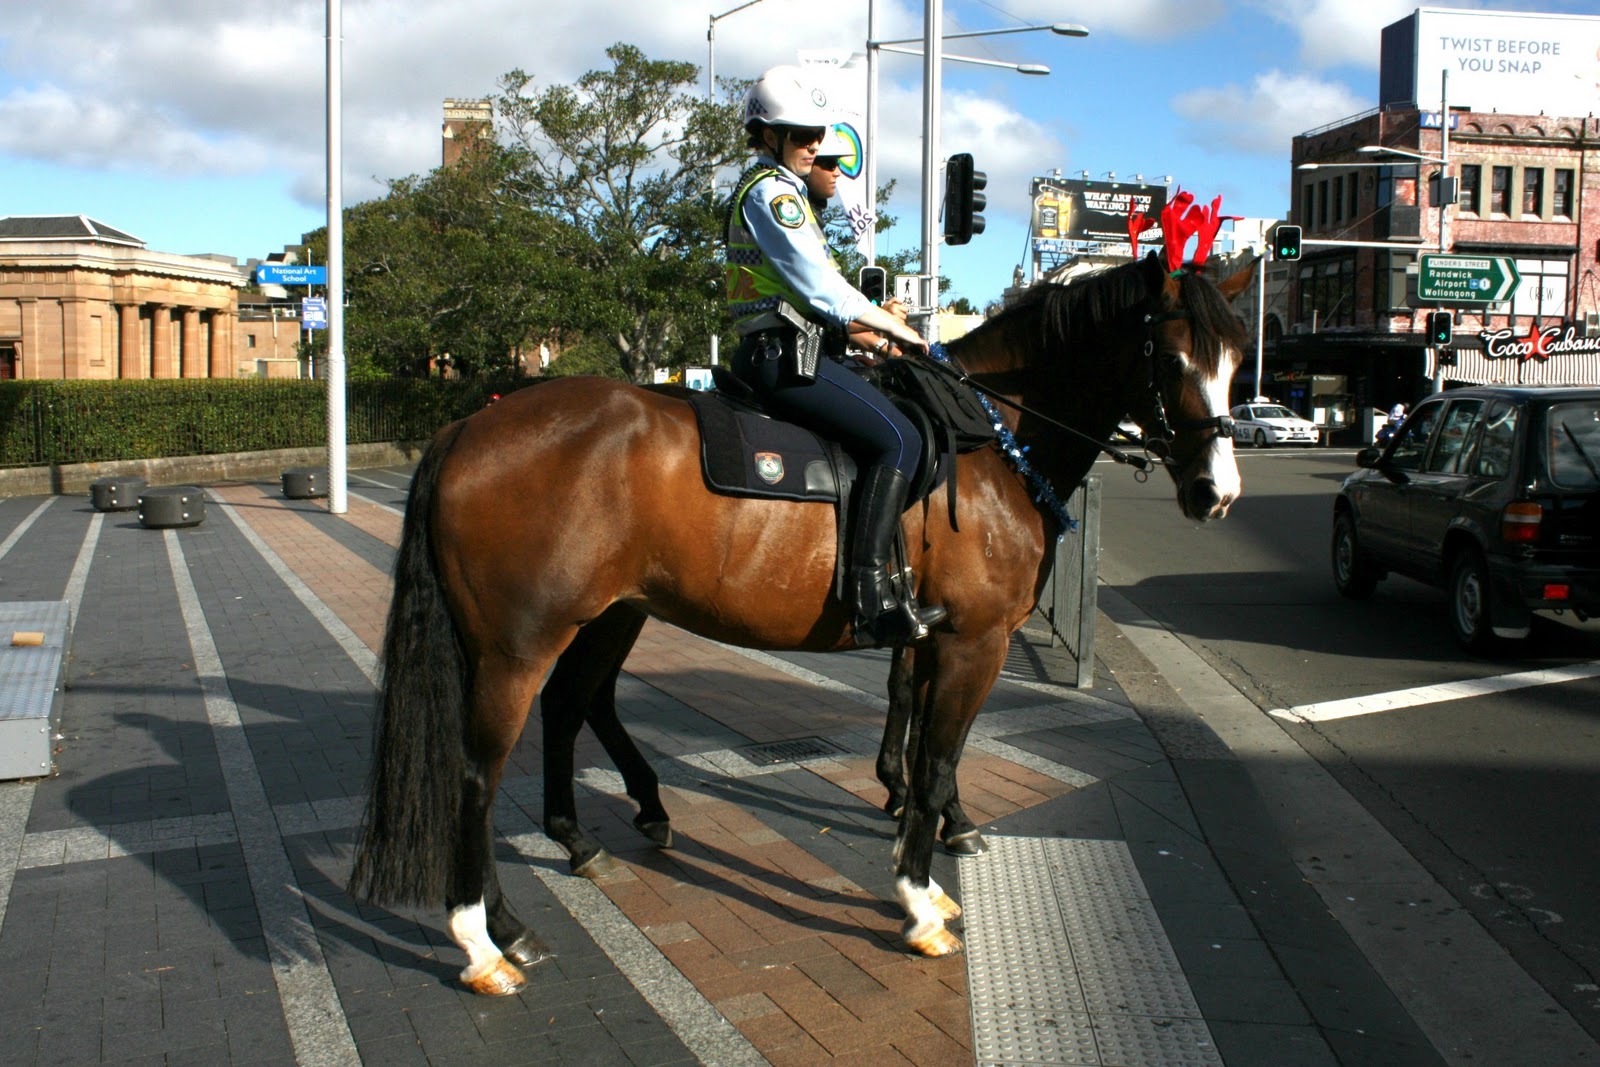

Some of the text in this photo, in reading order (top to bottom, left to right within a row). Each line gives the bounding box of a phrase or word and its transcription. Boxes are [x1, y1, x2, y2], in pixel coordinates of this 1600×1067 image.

[1440, 37, 1561, 56] TWIST BEFORE
[1458, 58, 1542, 74] YOU SNAP
[1083, 192, 1152, 204] WHAT ARE YOU
[1085, 201, 1150, 213] WAITING OR?
[1429, 260, 1463, 268] FLINDERS
[1429, 270, 1472, 278] Randwick
[1434, 280, 1467, 288] Airport
[1425, 288, 1476, 299] Wollongong
[1481, 330, 1533, 357] Coco
